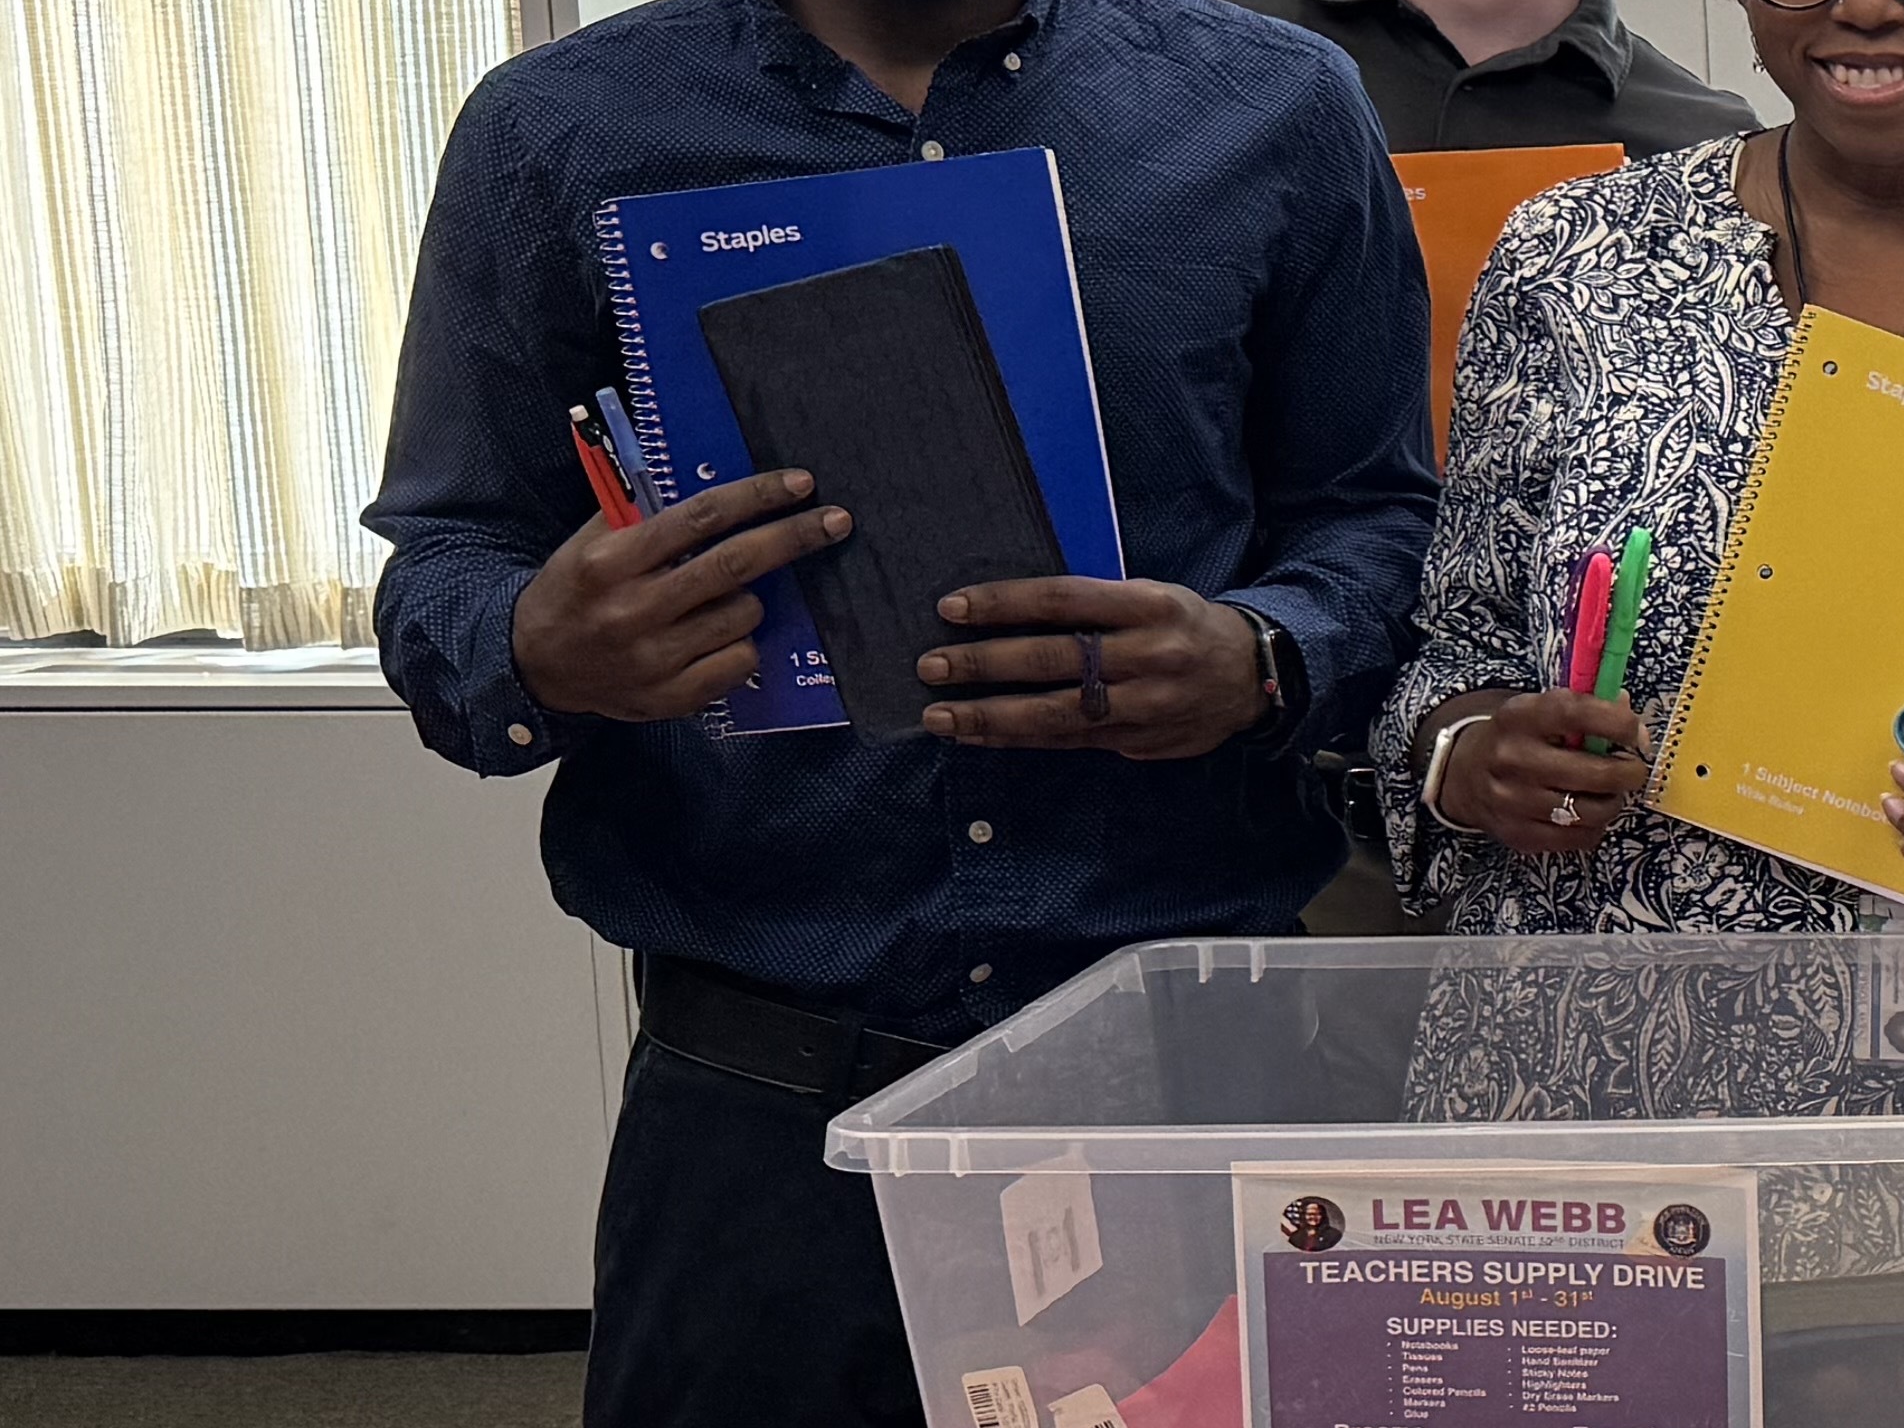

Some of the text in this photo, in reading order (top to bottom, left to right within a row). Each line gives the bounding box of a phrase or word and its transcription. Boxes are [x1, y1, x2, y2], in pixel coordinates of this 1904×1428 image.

[700, 223, 802, 255] Staples
[1754, 764, 1818, 801] Subject
[1372, 1199, 1627, 1235] LEA WEBB
[1300, 1260, 1705, 1290] TEACHERS SUPPLY DRIVE
[1419, 1288, 1500, 1310] August
[1386, 1317, 1618, 1340] SUPPLIES NEEDED:
